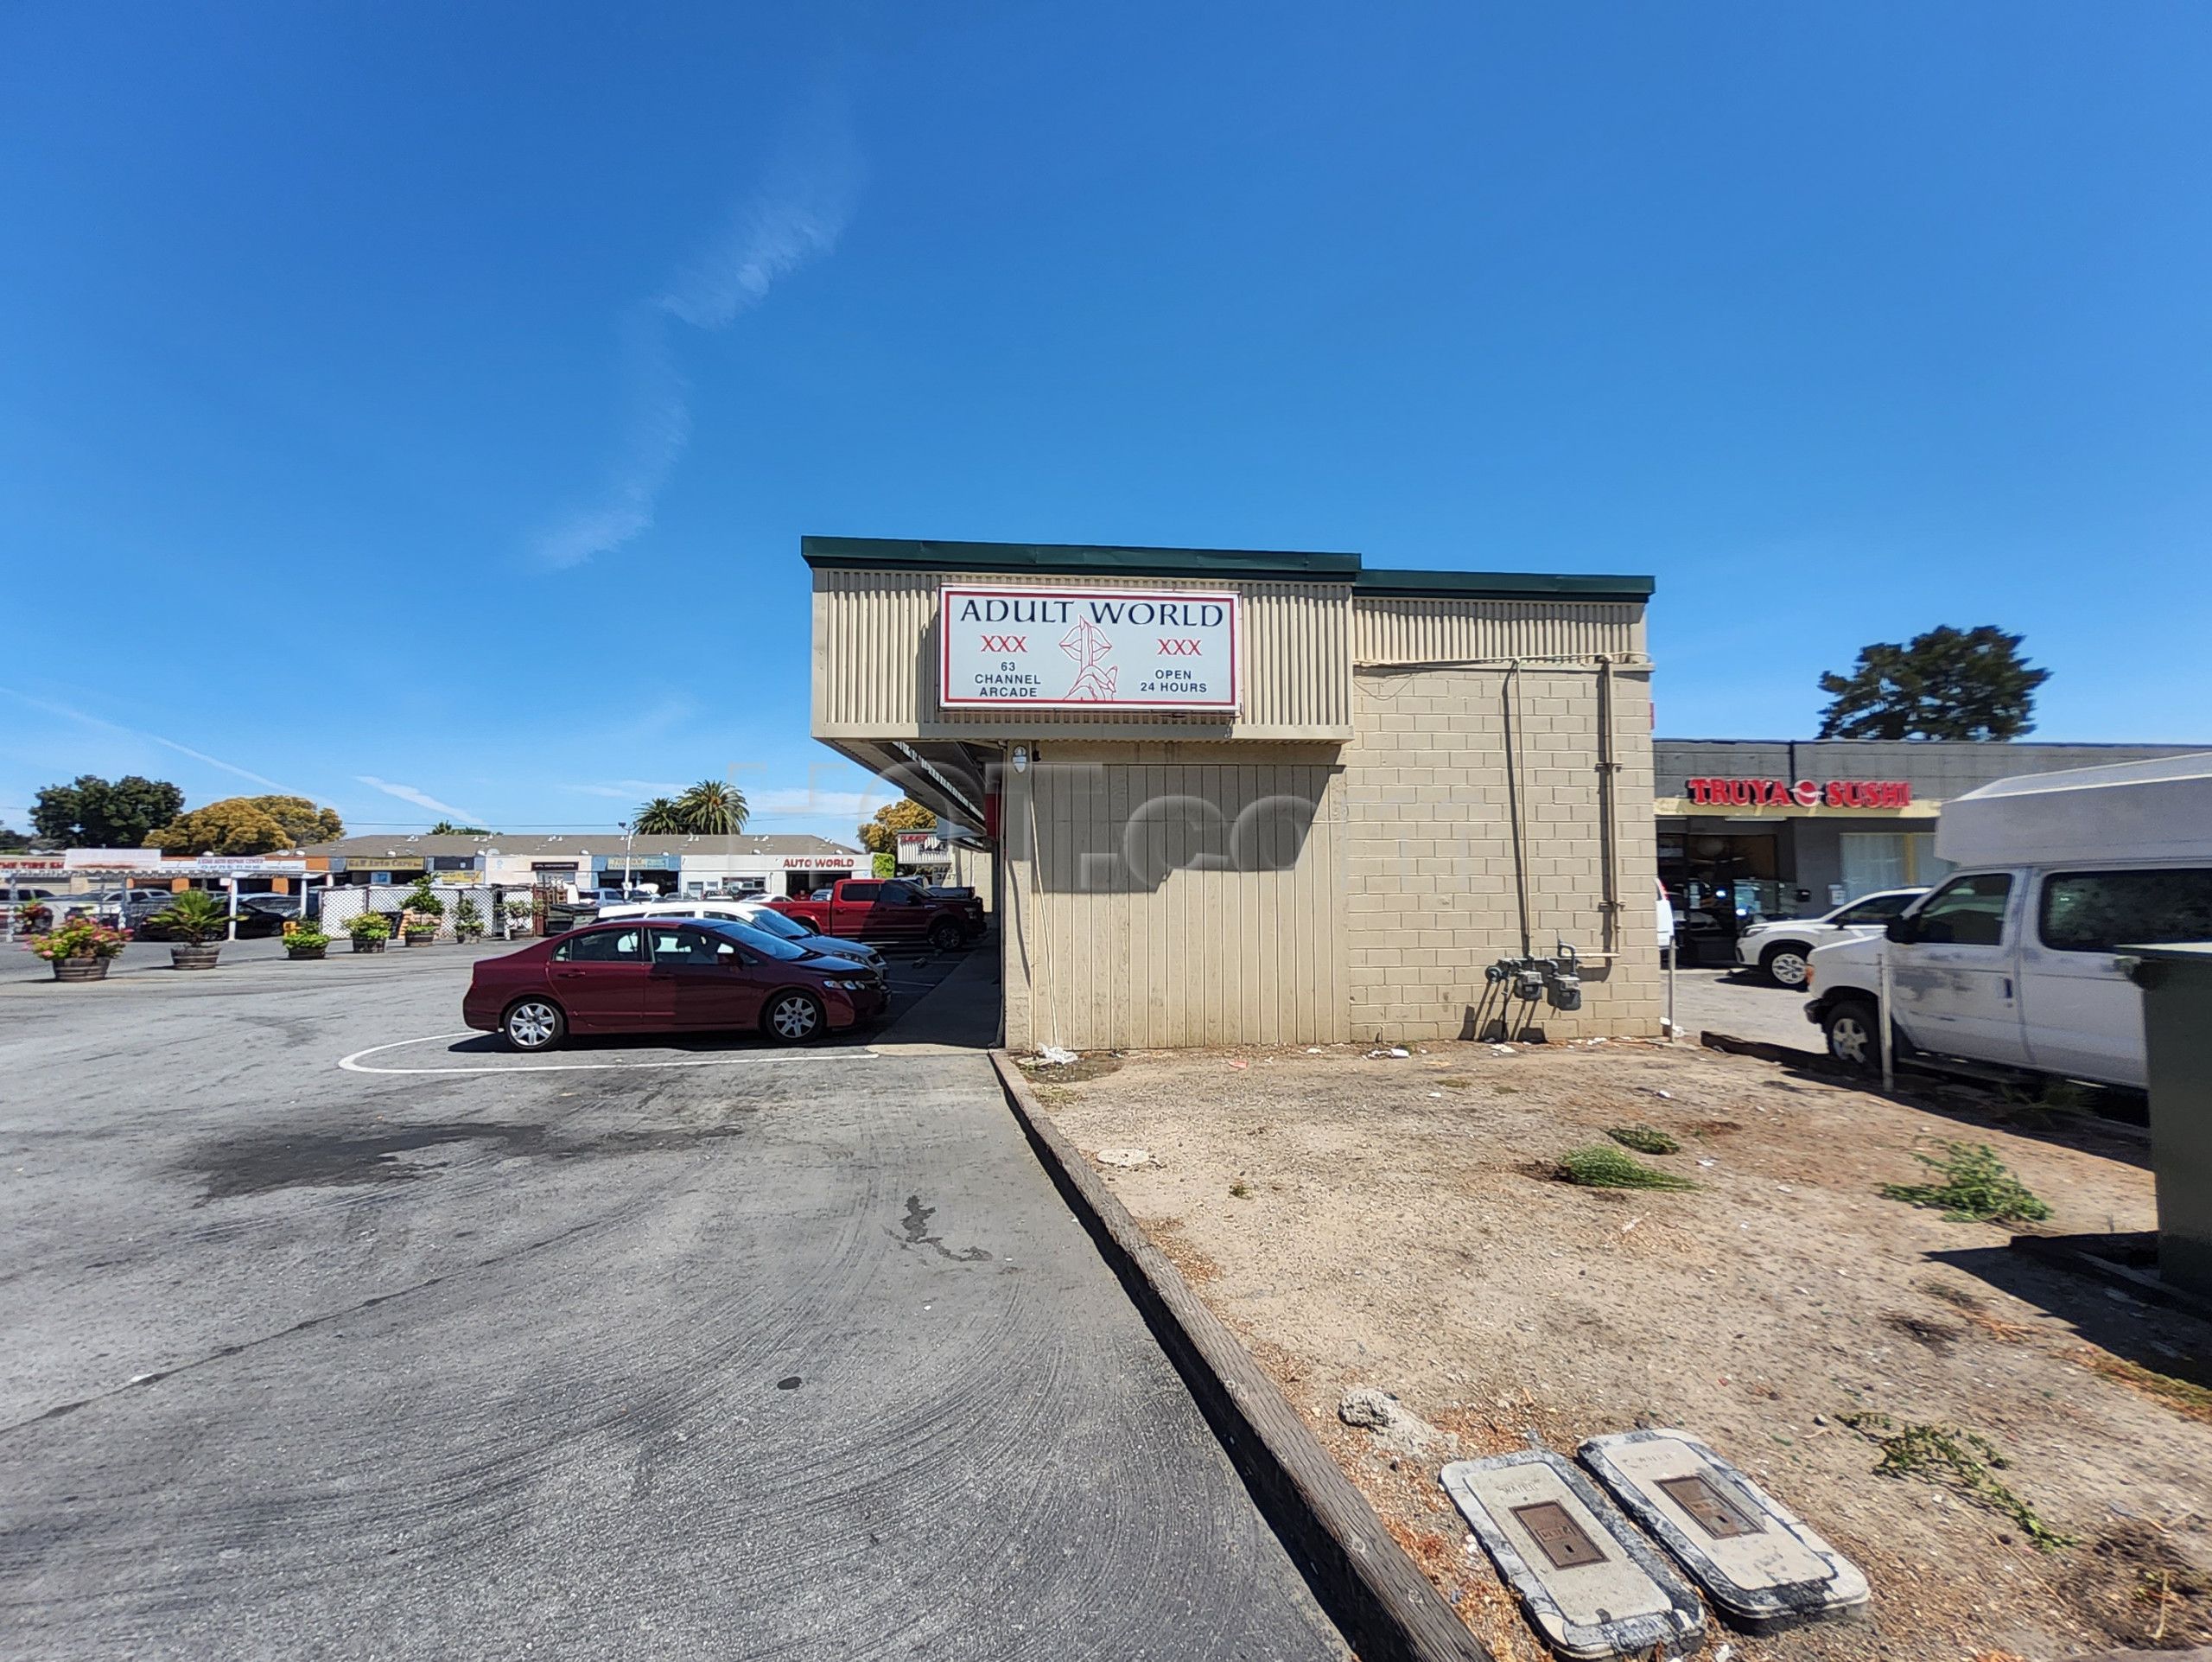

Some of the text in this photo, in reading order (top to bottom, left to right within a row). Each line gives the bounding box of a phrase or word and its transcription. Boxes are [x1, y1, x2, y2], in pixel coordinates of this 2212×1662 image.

[960, 599, 1224, 627] ADULT WORLD
[981, 635, 1027, 653] XXX
[1157, 639, 1202, 656] XXX
[1001, 661, 1016, 672] 63
[975, 674, 1041, 685] CHANNEL
[1154, 669, 1192, 680] OPEN
[979, 687, 1037, 697] ARCADE
[1141, 682, 1207, 693] 24 HOURS
[1687, 778, 1913, 809] TRUYA SUSHI
[783, 858, 855, 868] AUTO WORLD
